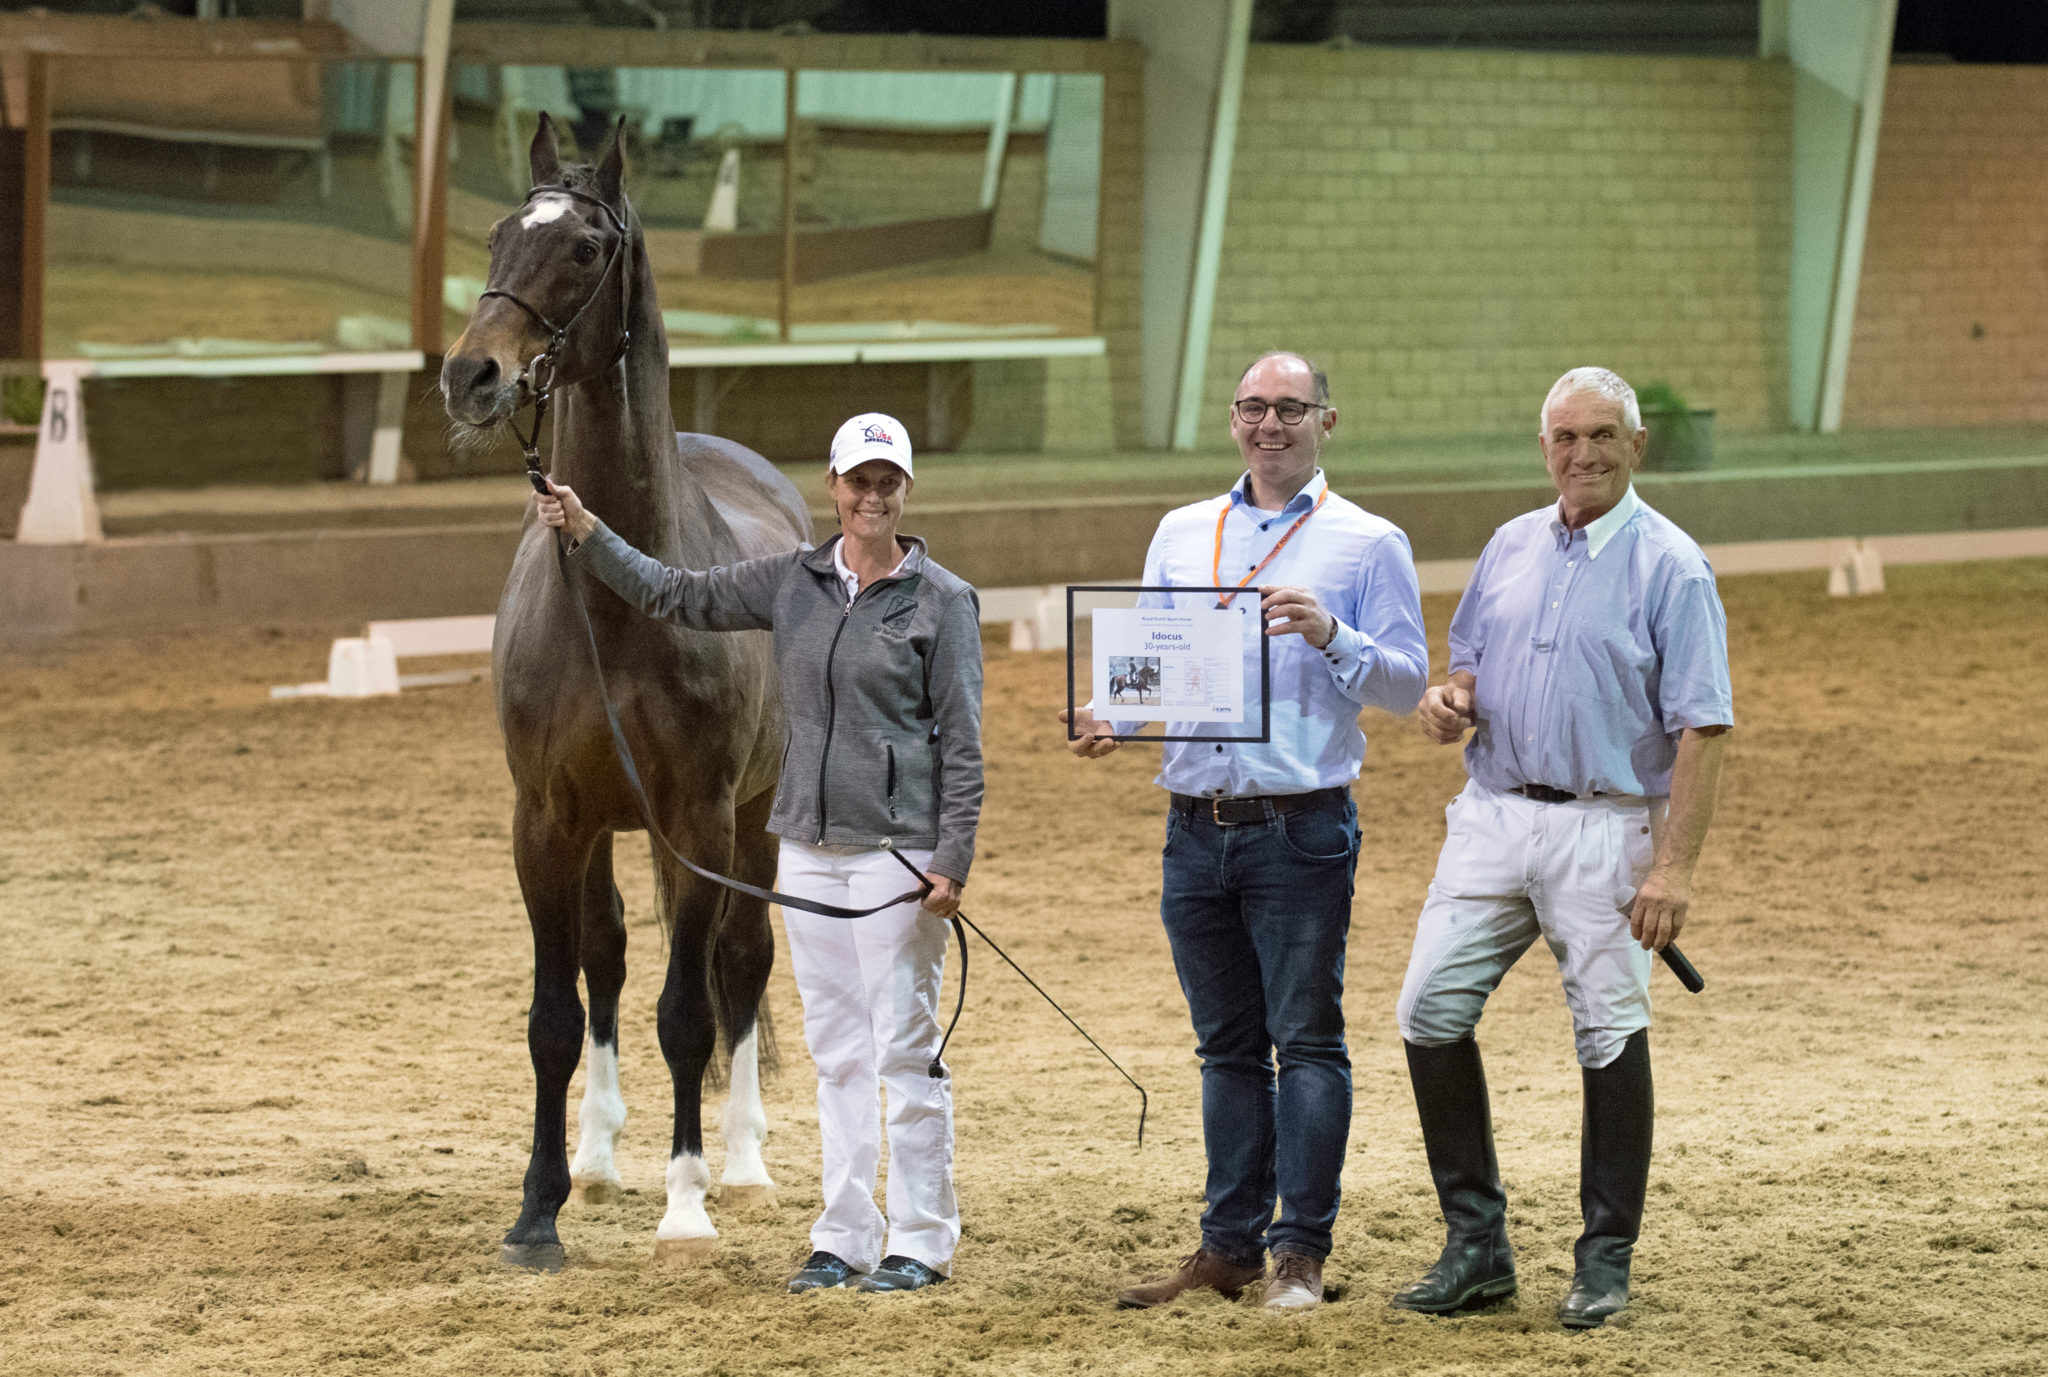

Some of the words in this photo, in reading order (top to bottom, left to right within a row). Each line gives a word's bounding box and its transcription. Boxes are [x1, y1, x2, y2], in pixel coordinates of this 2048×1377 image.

[875, 432, 892, 442] USA
[1151, 631, 1183, 641] Idocus
[1143, 641, 1191, 652] 30-years-old
